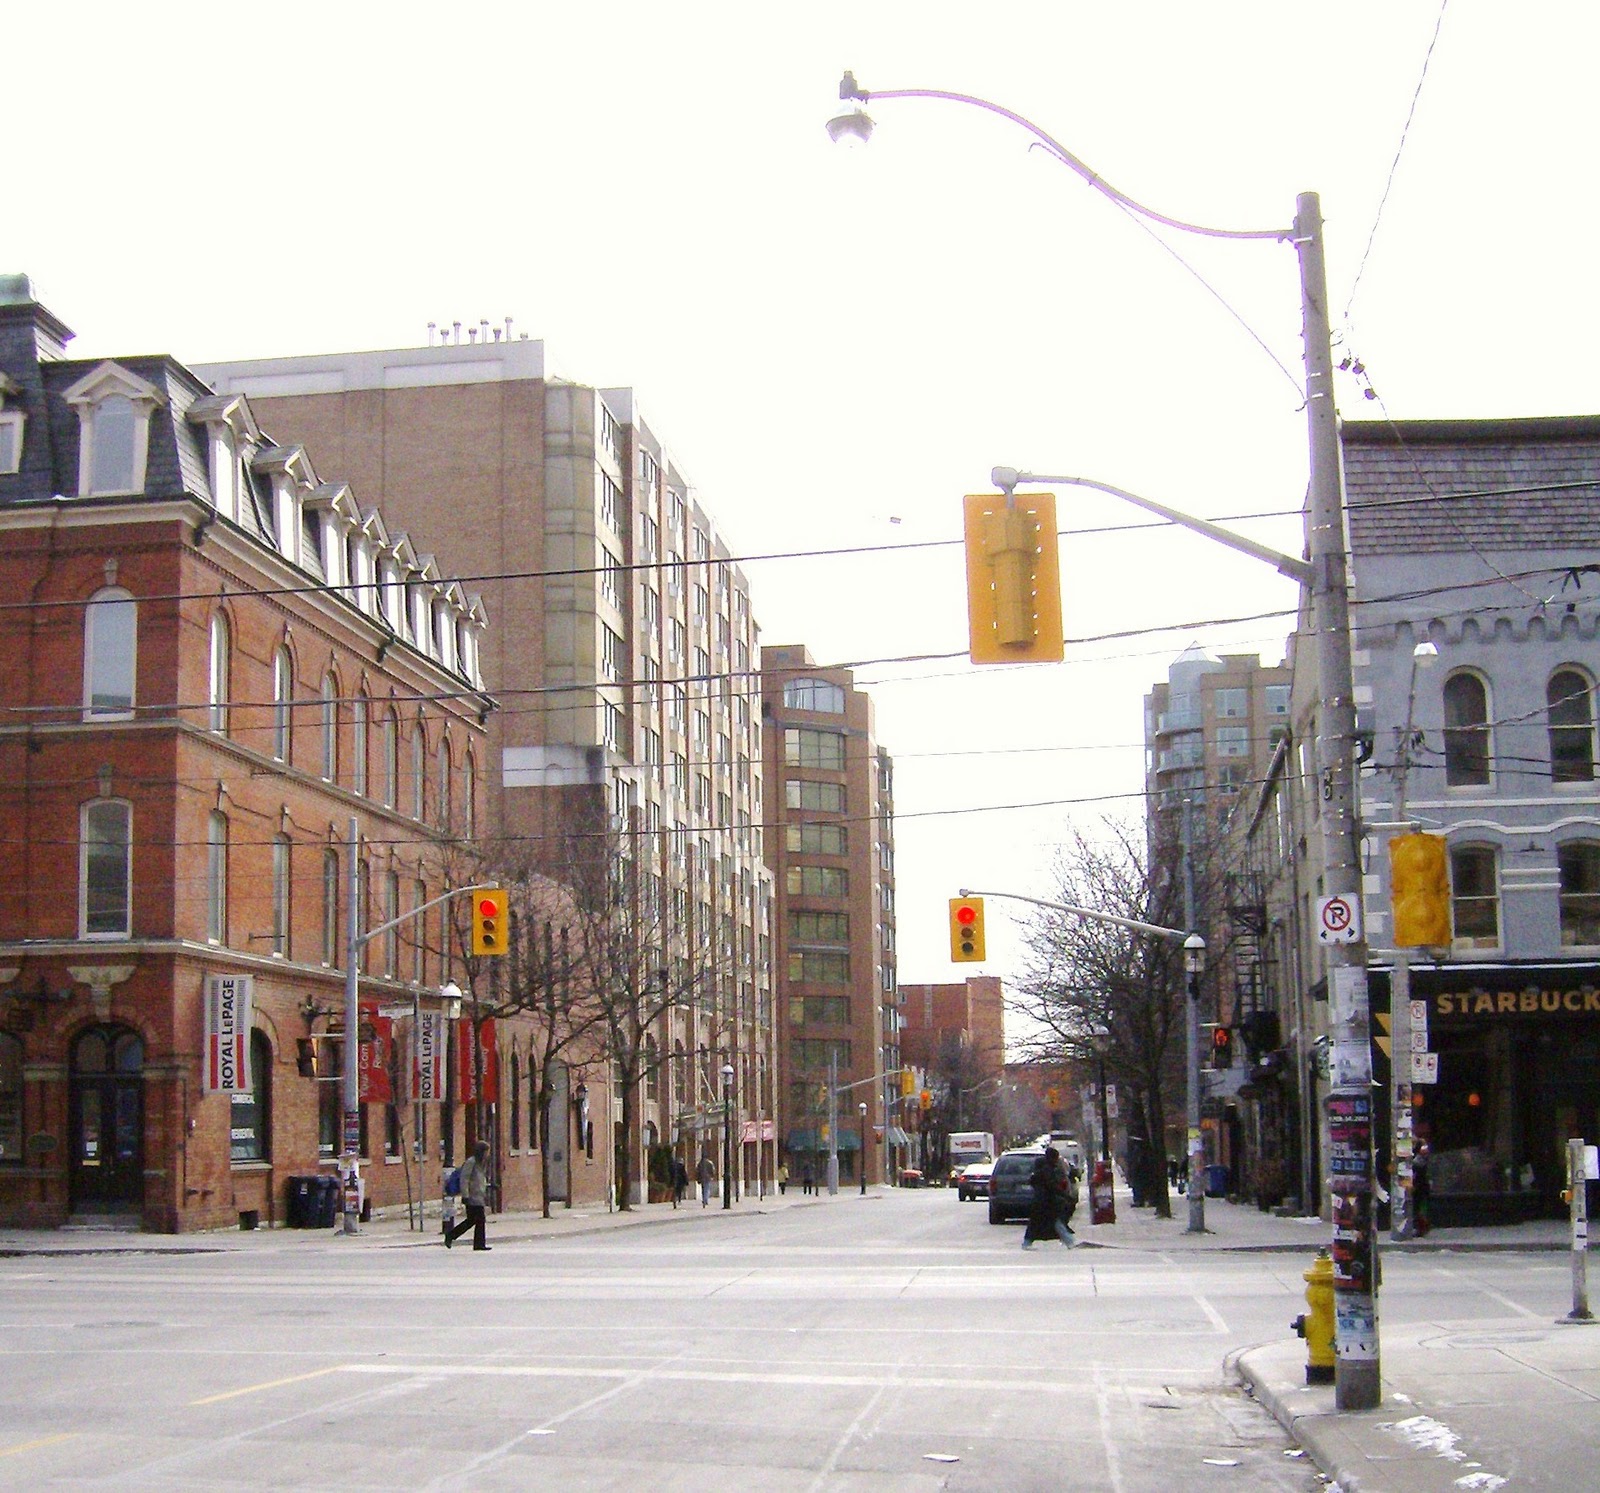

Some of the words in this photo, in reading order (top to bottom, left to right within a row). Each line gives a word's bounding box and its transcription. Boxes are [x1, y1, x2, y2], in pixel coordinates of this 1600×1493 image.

[1436, 990, 1600, 1014] STARBUCK
[221, 1038, 234, 1090] ROYAL
[421, 1059, 432, 1099] ROYAL
